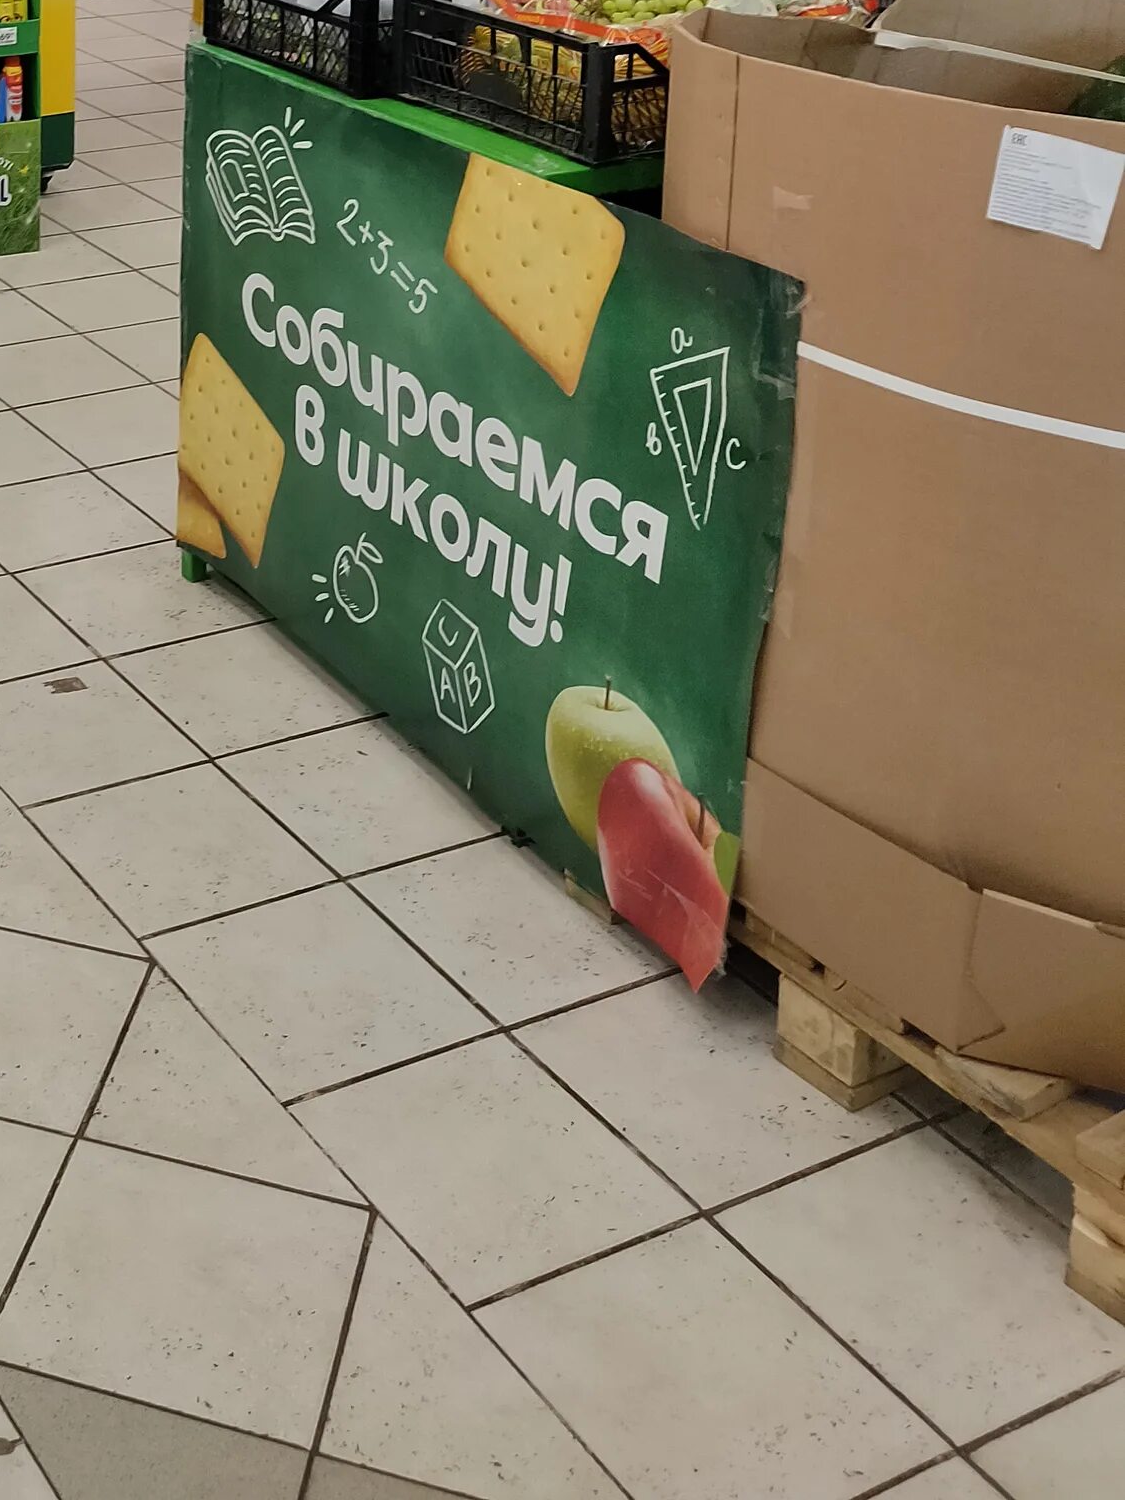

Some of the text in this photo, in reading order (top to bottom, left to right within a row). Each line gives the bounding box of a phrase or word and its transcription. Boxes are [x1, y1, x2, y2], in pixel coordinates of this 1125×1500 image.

[336, 199, 438, 314] 2+3=5
[241, 272, 669, 584] Собираемся
[293, 385, 573, 647] в школу!
[440, 661, 482, 708] A B
